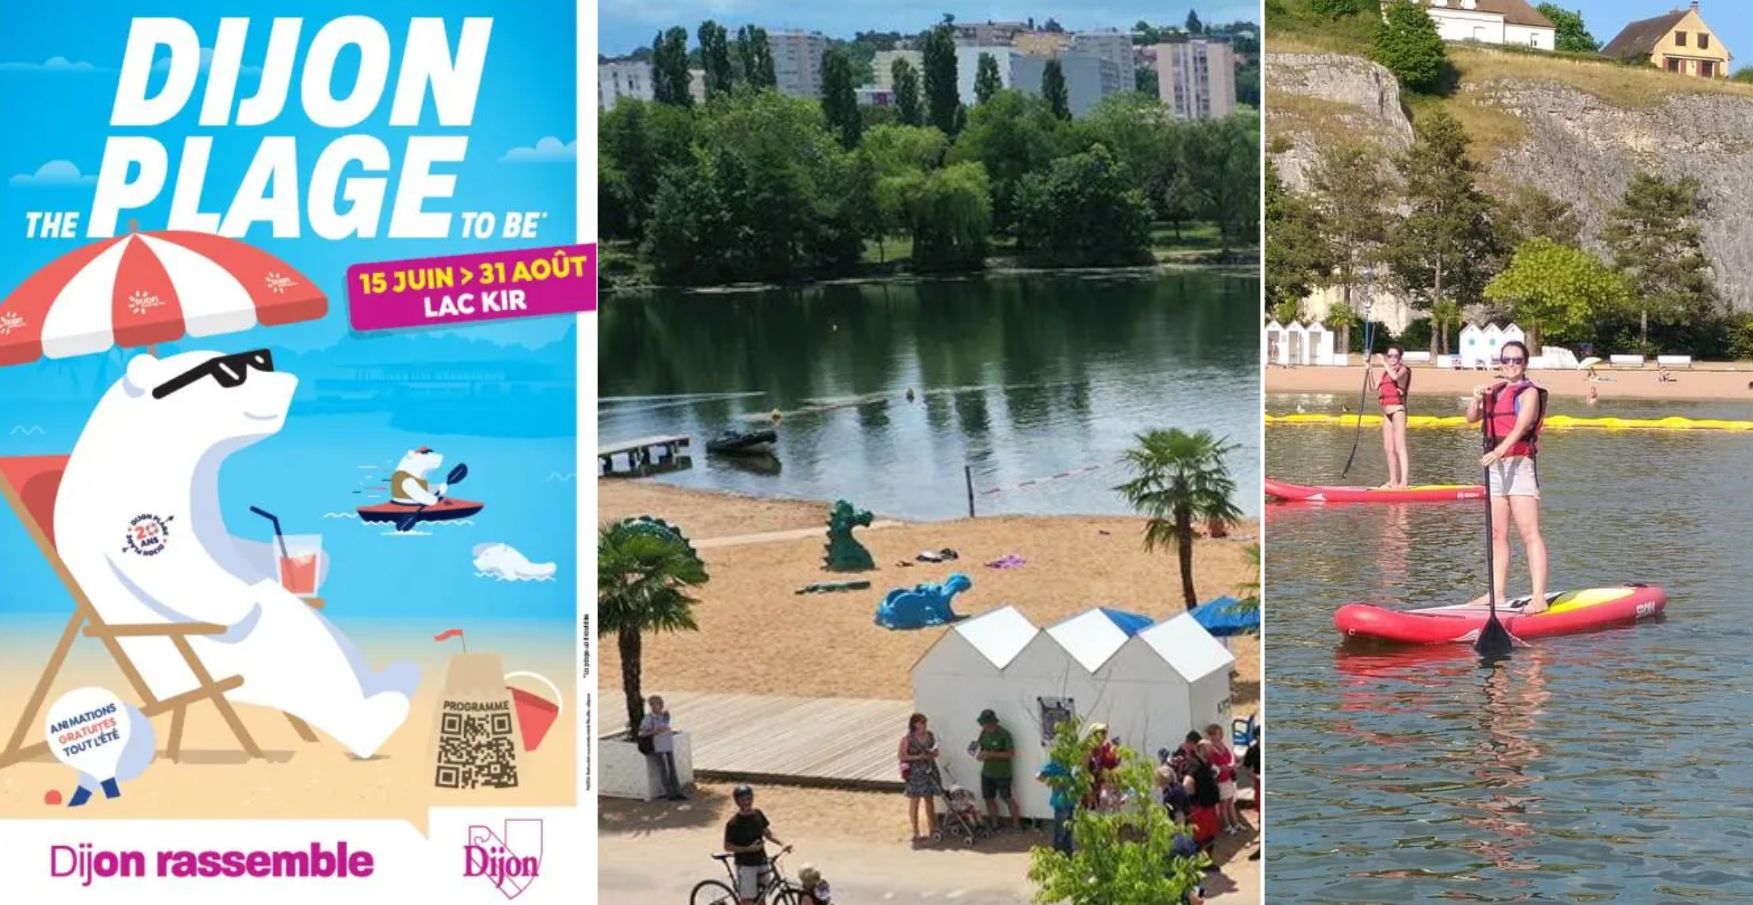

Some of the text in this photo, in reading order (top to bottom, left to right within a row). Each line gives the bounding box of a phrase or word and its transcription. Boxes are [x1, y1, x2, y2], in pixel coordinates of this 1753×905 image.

[109, 15, 494, 128] DIJON
[25, 211, 80, 238] THE
[86, 134, 469, 240] PLAGE
[461, 211, 496, 239] TO
[359, 272, 388, 295] 15
[392, 266, 454, 294] JUIN
[478, 261, 506, 284] 31
[511, 249, 587, 283] AOÛT
[423, 289, 527, 319] LAC KIR
[141, 537, 159, 547] ANS
[50, 703, 117, 734] ANIMATIONS
[443, 700, 510, 712] PROGRAMME
[58, 717, 117, 744] GRATUITES
[62, 739, 93, 757] TOUT
[50, 841, 375, 887] Dijon rassemble
[463, 845, 540, 888] Dijon
